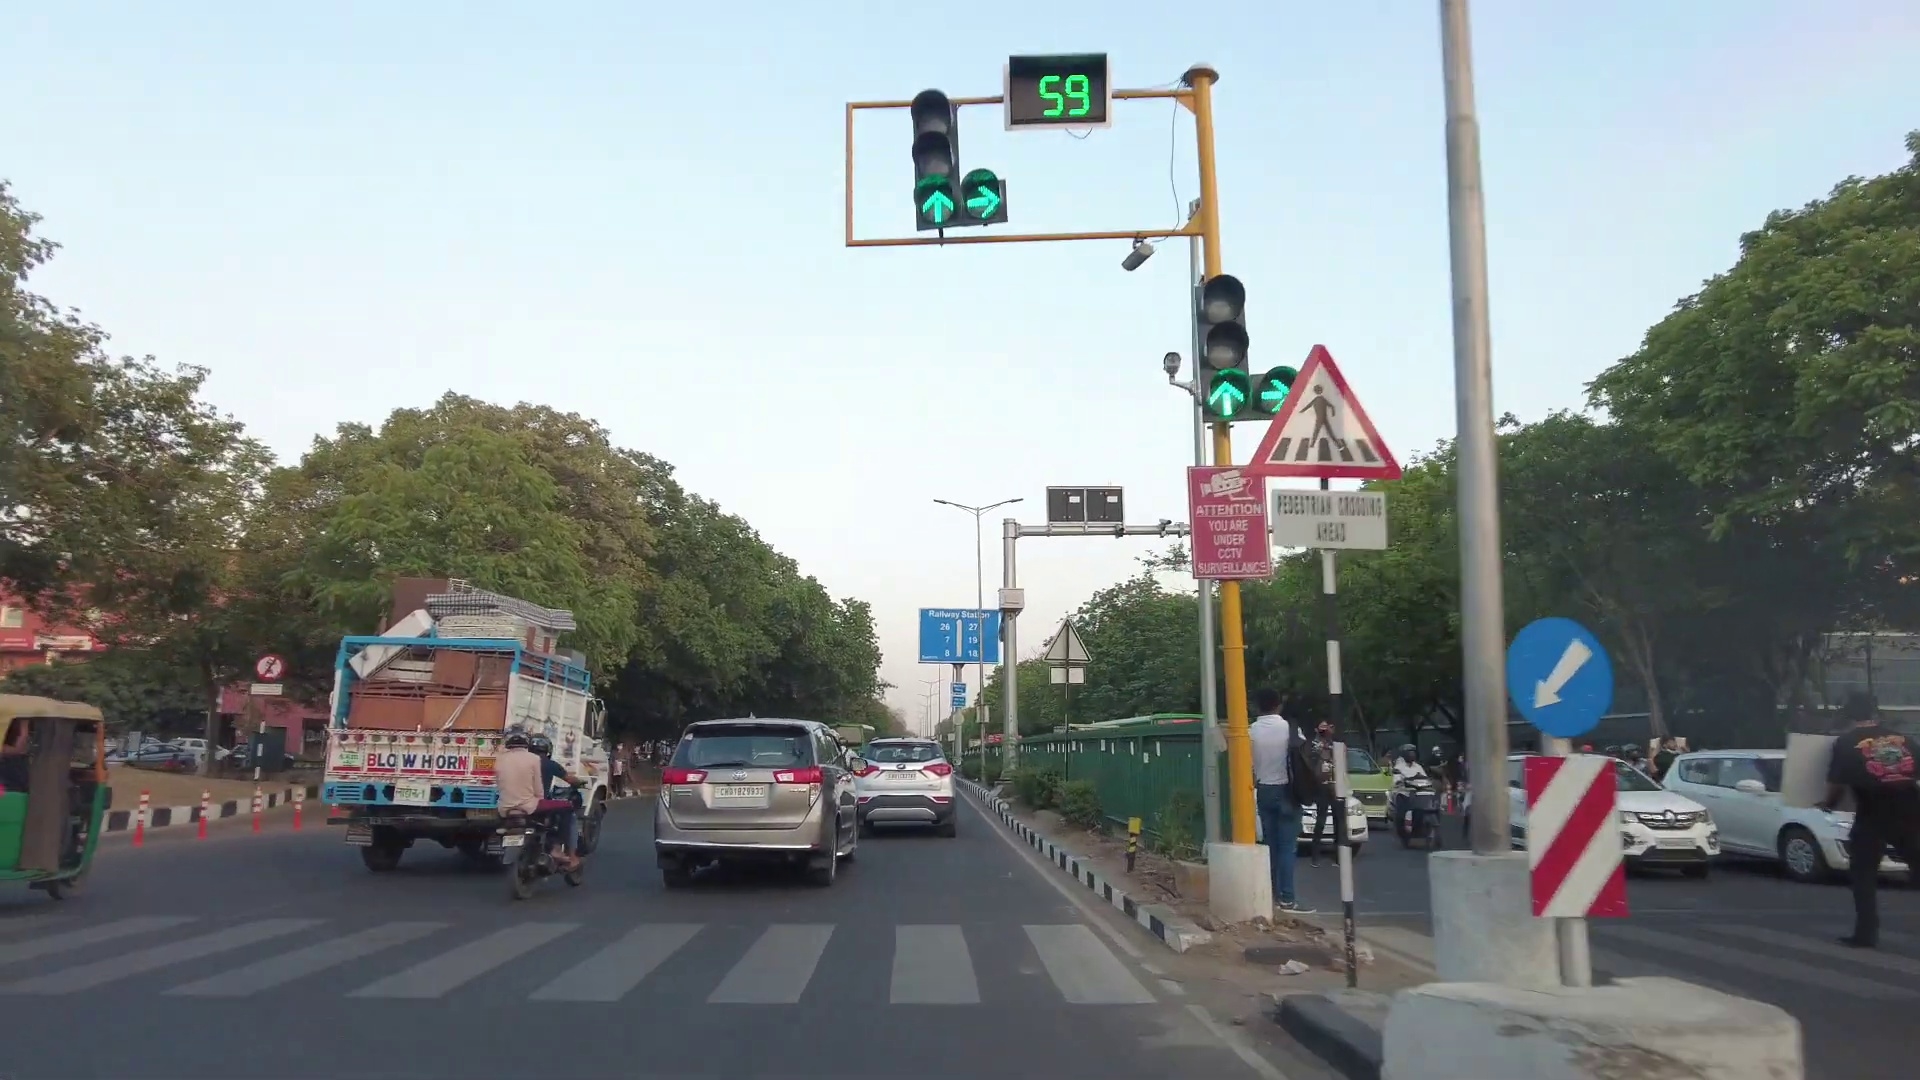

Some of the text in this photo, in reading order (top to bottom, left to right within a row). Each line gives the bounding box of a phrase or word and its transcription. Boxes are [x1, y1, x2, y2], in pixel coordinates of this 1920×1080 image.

[1039, 74, 1090, 116] 59
[1196, 503, 1262, 516] ATTENTION
[1277, 495, 1331, 516] PEDESTRIAN
[1208, 519, 1249, 532] YOU ARE
[1213, 534, 1246, 546] UNDER
[1217, 547, 1243, 559] CCTV
[1198, 561, 1267, 574] SURVEILLANCE
[928, 610, 960, 619] Railway
[940, 623, 951, 631] 26
[968, 623, 978, 631] 27
[968, 636, 978, 644] 19
[367, 753, 416, 769] BLOW
[422, 754, 467, 770] HORN
